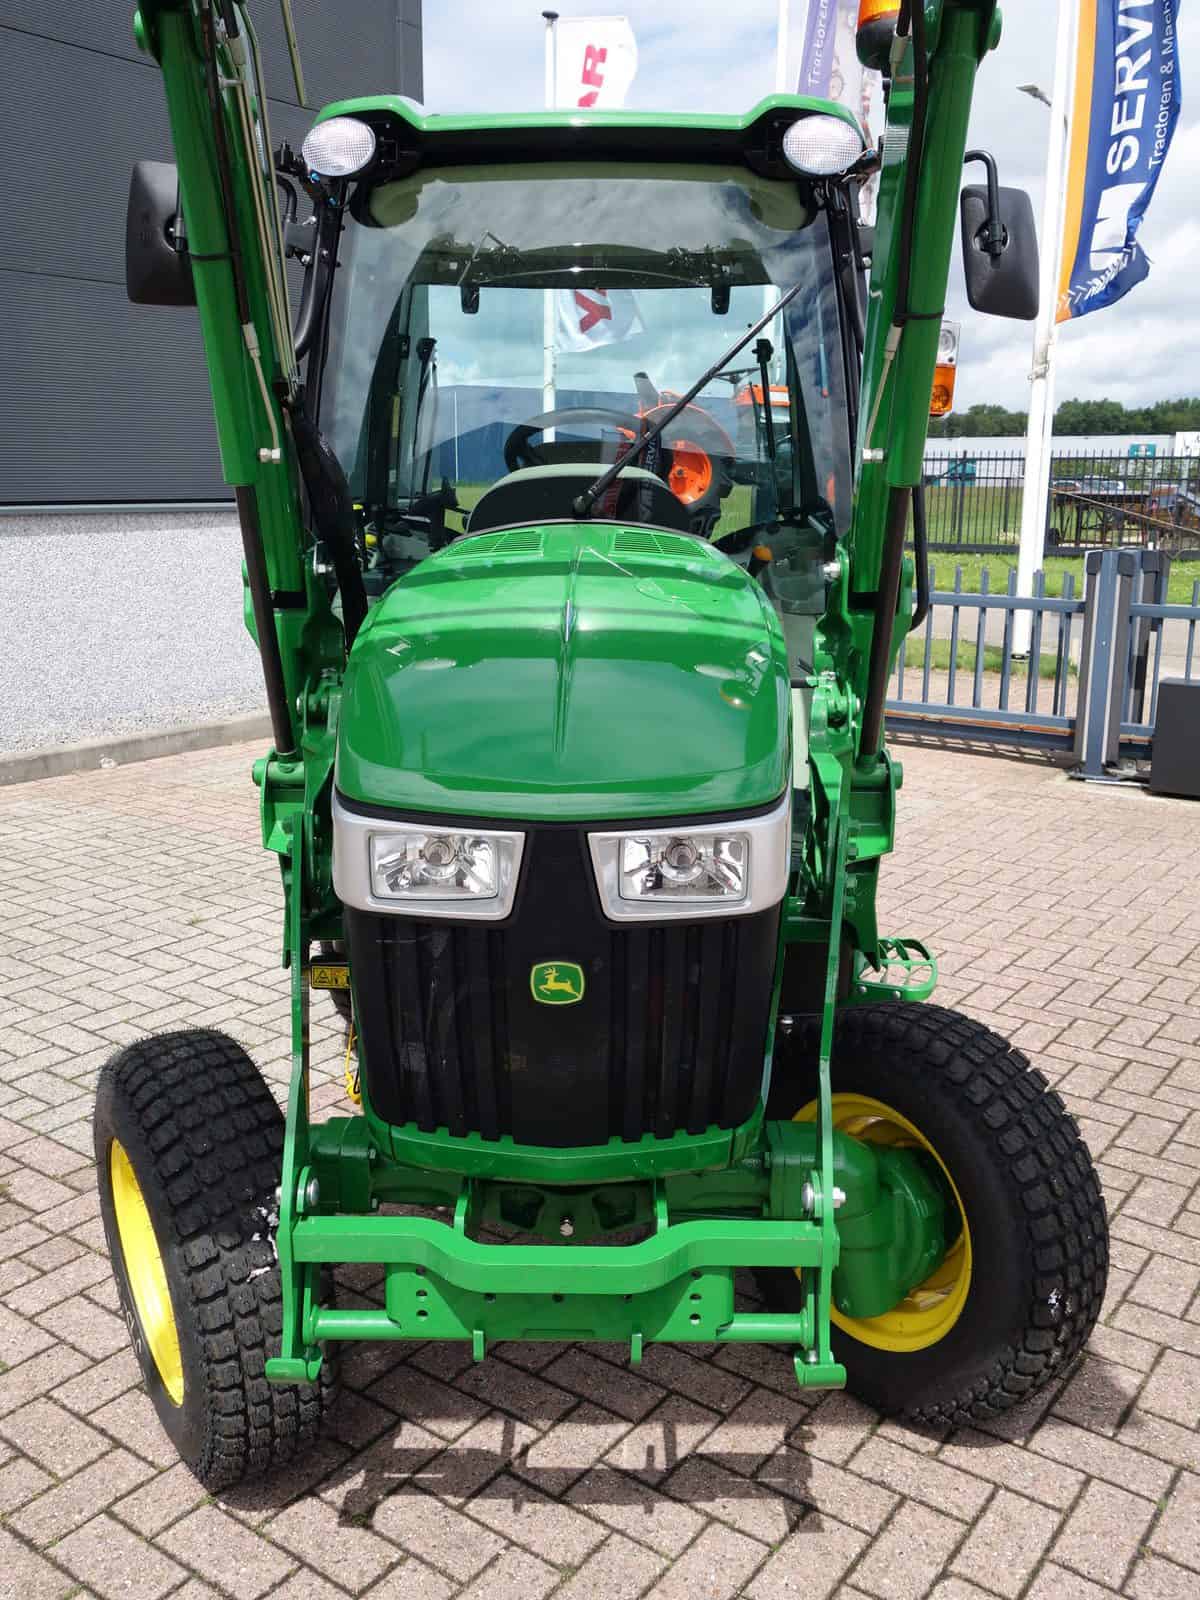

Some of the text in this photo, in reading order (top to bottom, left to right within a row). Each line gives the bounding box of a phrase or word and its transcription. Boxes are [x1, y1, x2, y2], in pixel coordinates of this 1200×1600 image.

[1149, 0, 1174, 169] Tractoren & Mach
